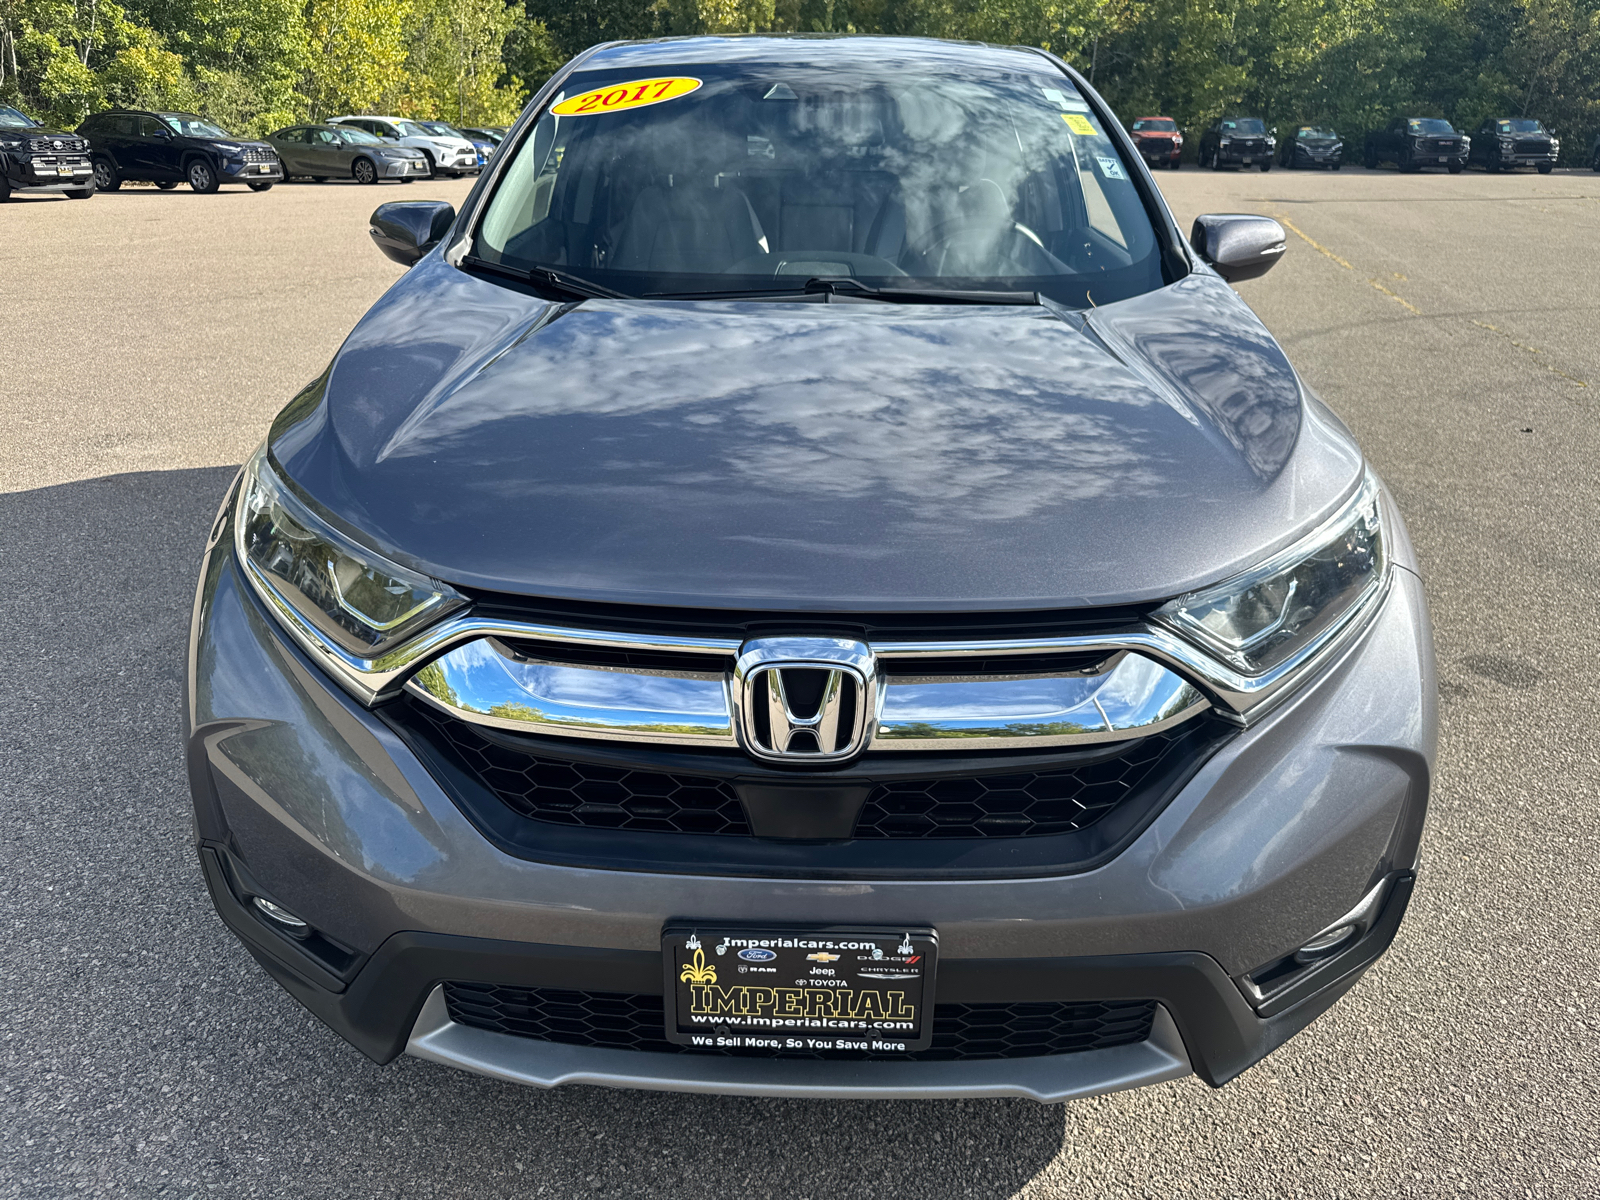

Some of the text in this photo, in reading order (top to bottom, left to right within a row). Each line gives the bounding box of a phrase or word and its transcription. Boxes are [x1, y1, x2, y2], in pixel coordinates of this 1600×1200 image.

[574, 80, 675, 112] 2017
[723, 937, 876, 950] Imperialcars.com
[809, 967, 835, 976] Jeep
[809, 979, 848, 987] TOYOTA
[690, 984, 914, 1019] IMPERIAL
[691, 1015, 914, 1029] www.imperialcars.com
[692, 1036, 906, 1050] We Sell More, So You Save More
